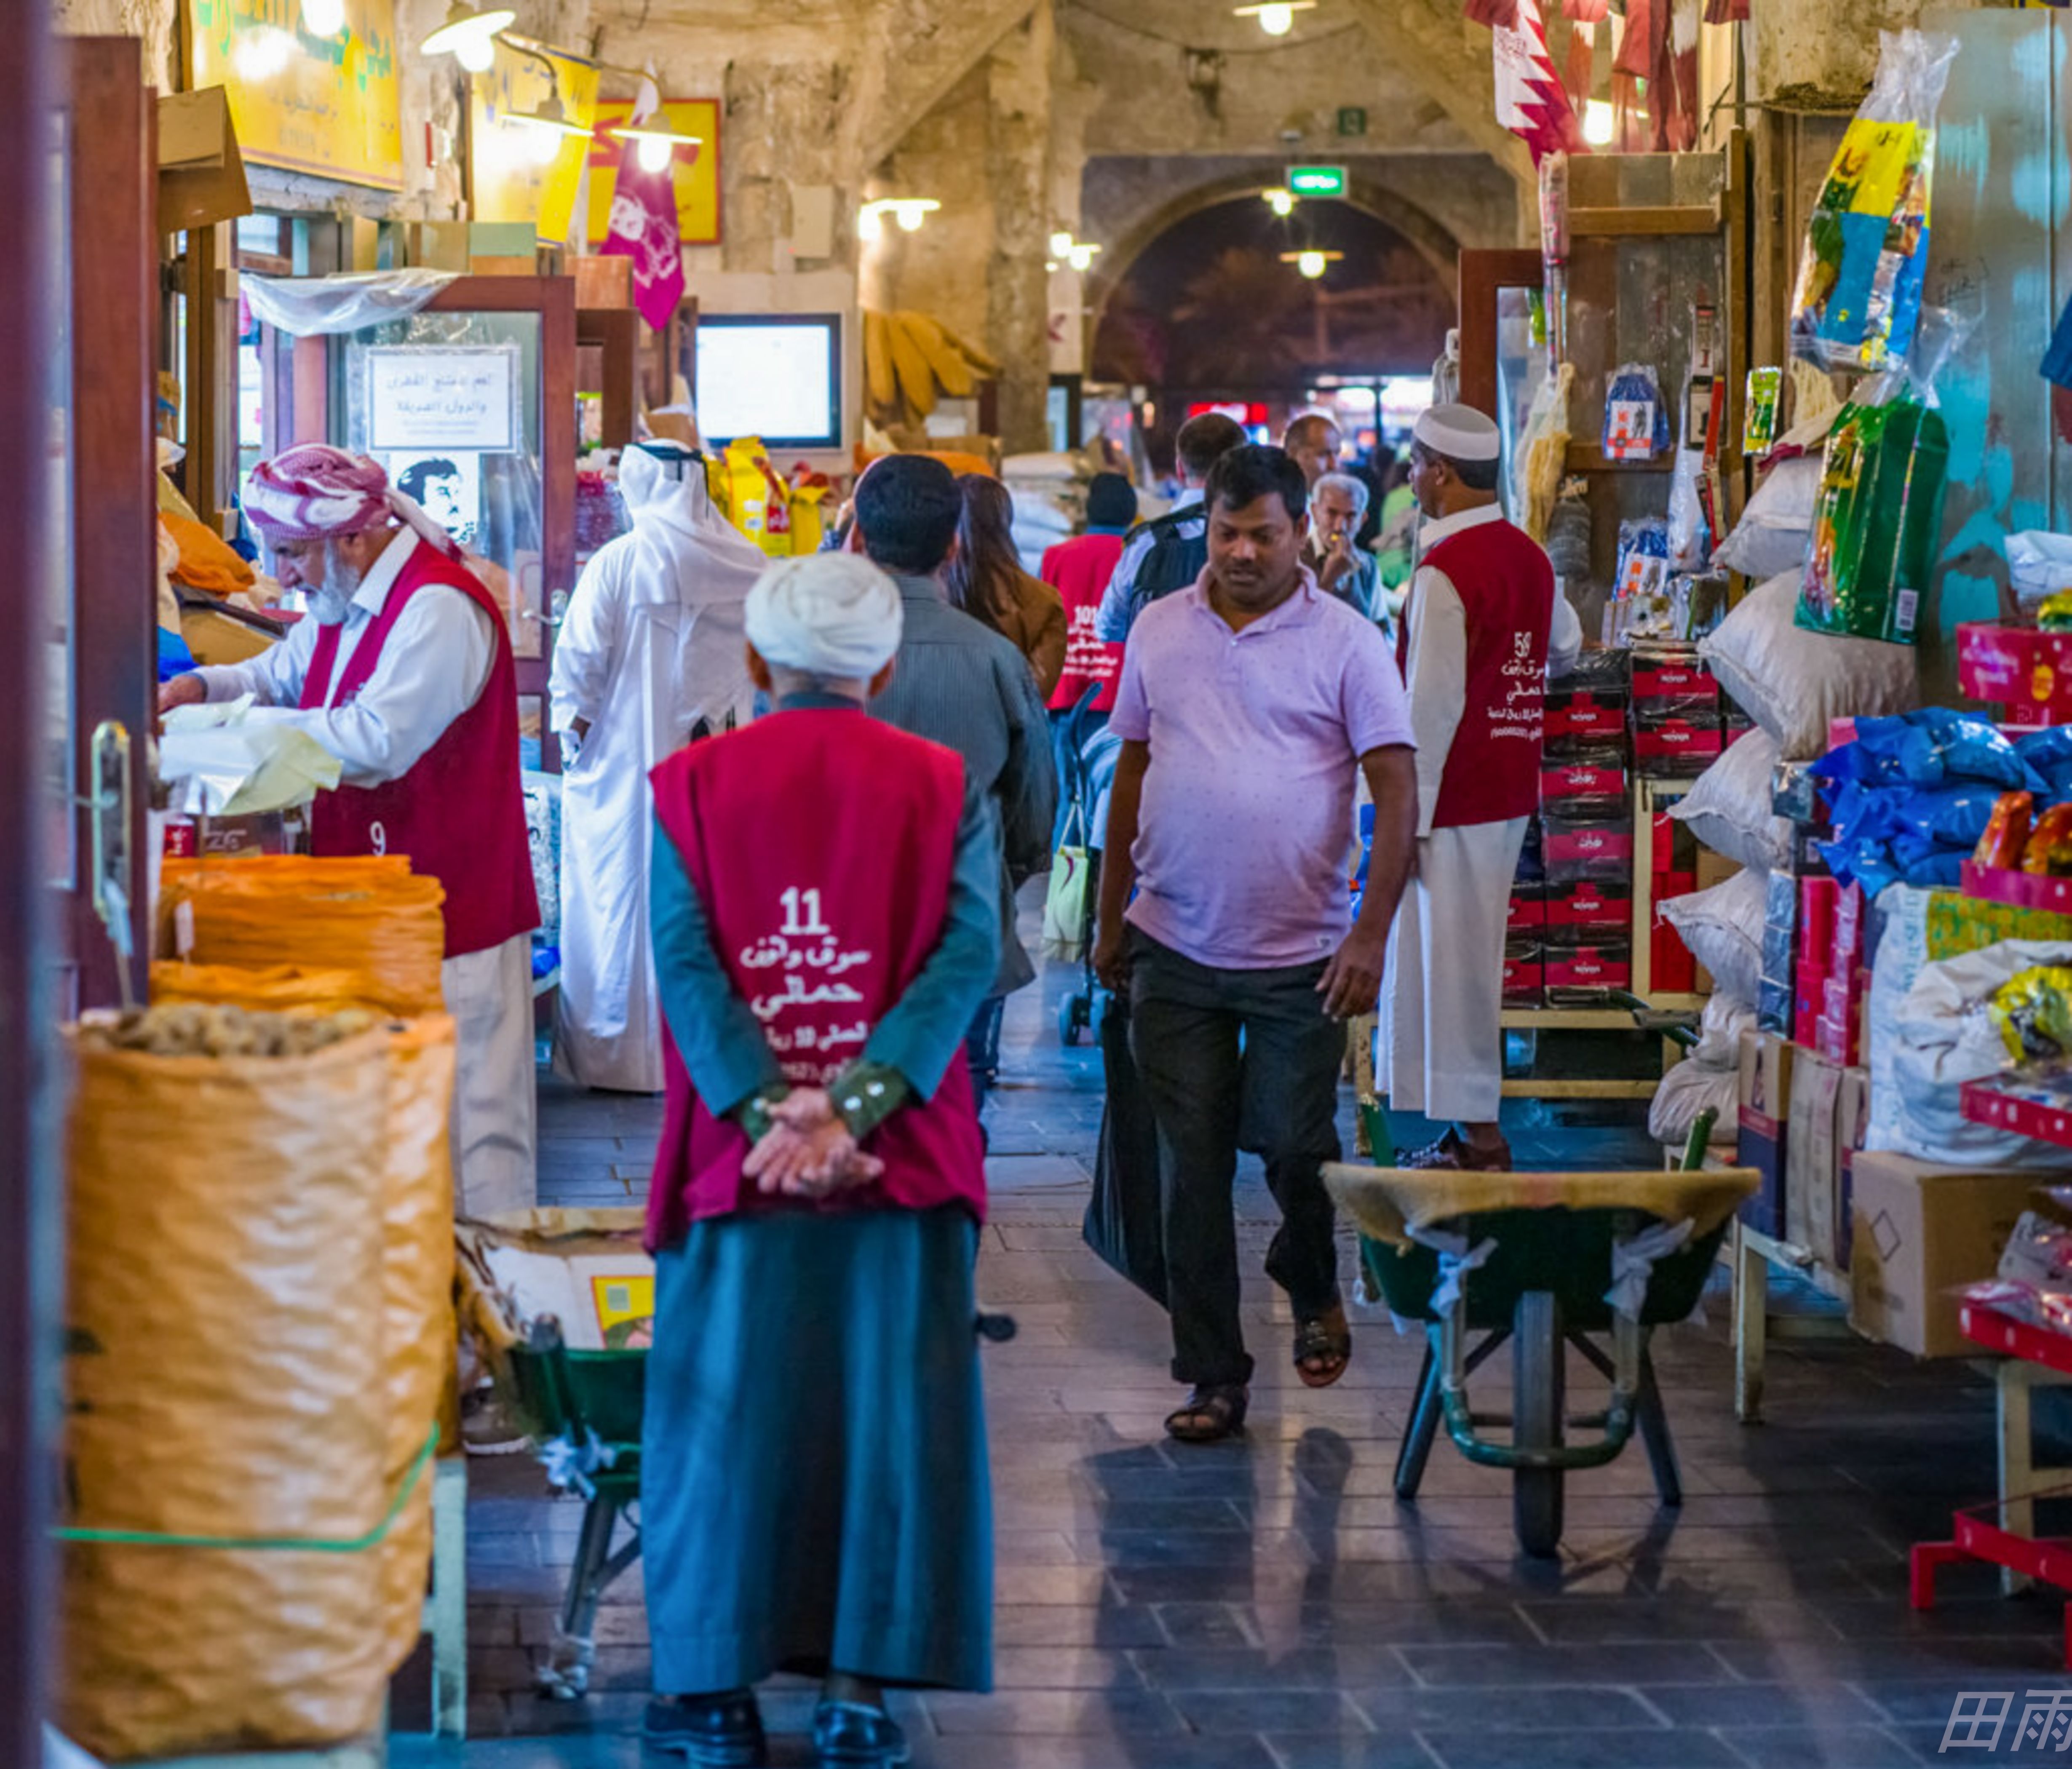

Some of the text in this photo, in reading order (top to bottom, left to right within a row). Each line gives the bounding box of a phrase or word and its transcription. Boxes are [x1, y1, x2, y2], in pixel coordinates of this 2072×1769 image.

[780, 885, 831, 935] 11
[739, 935, 872, 974] سوق واقف
[751, 974, 864, 1021] حمالي
